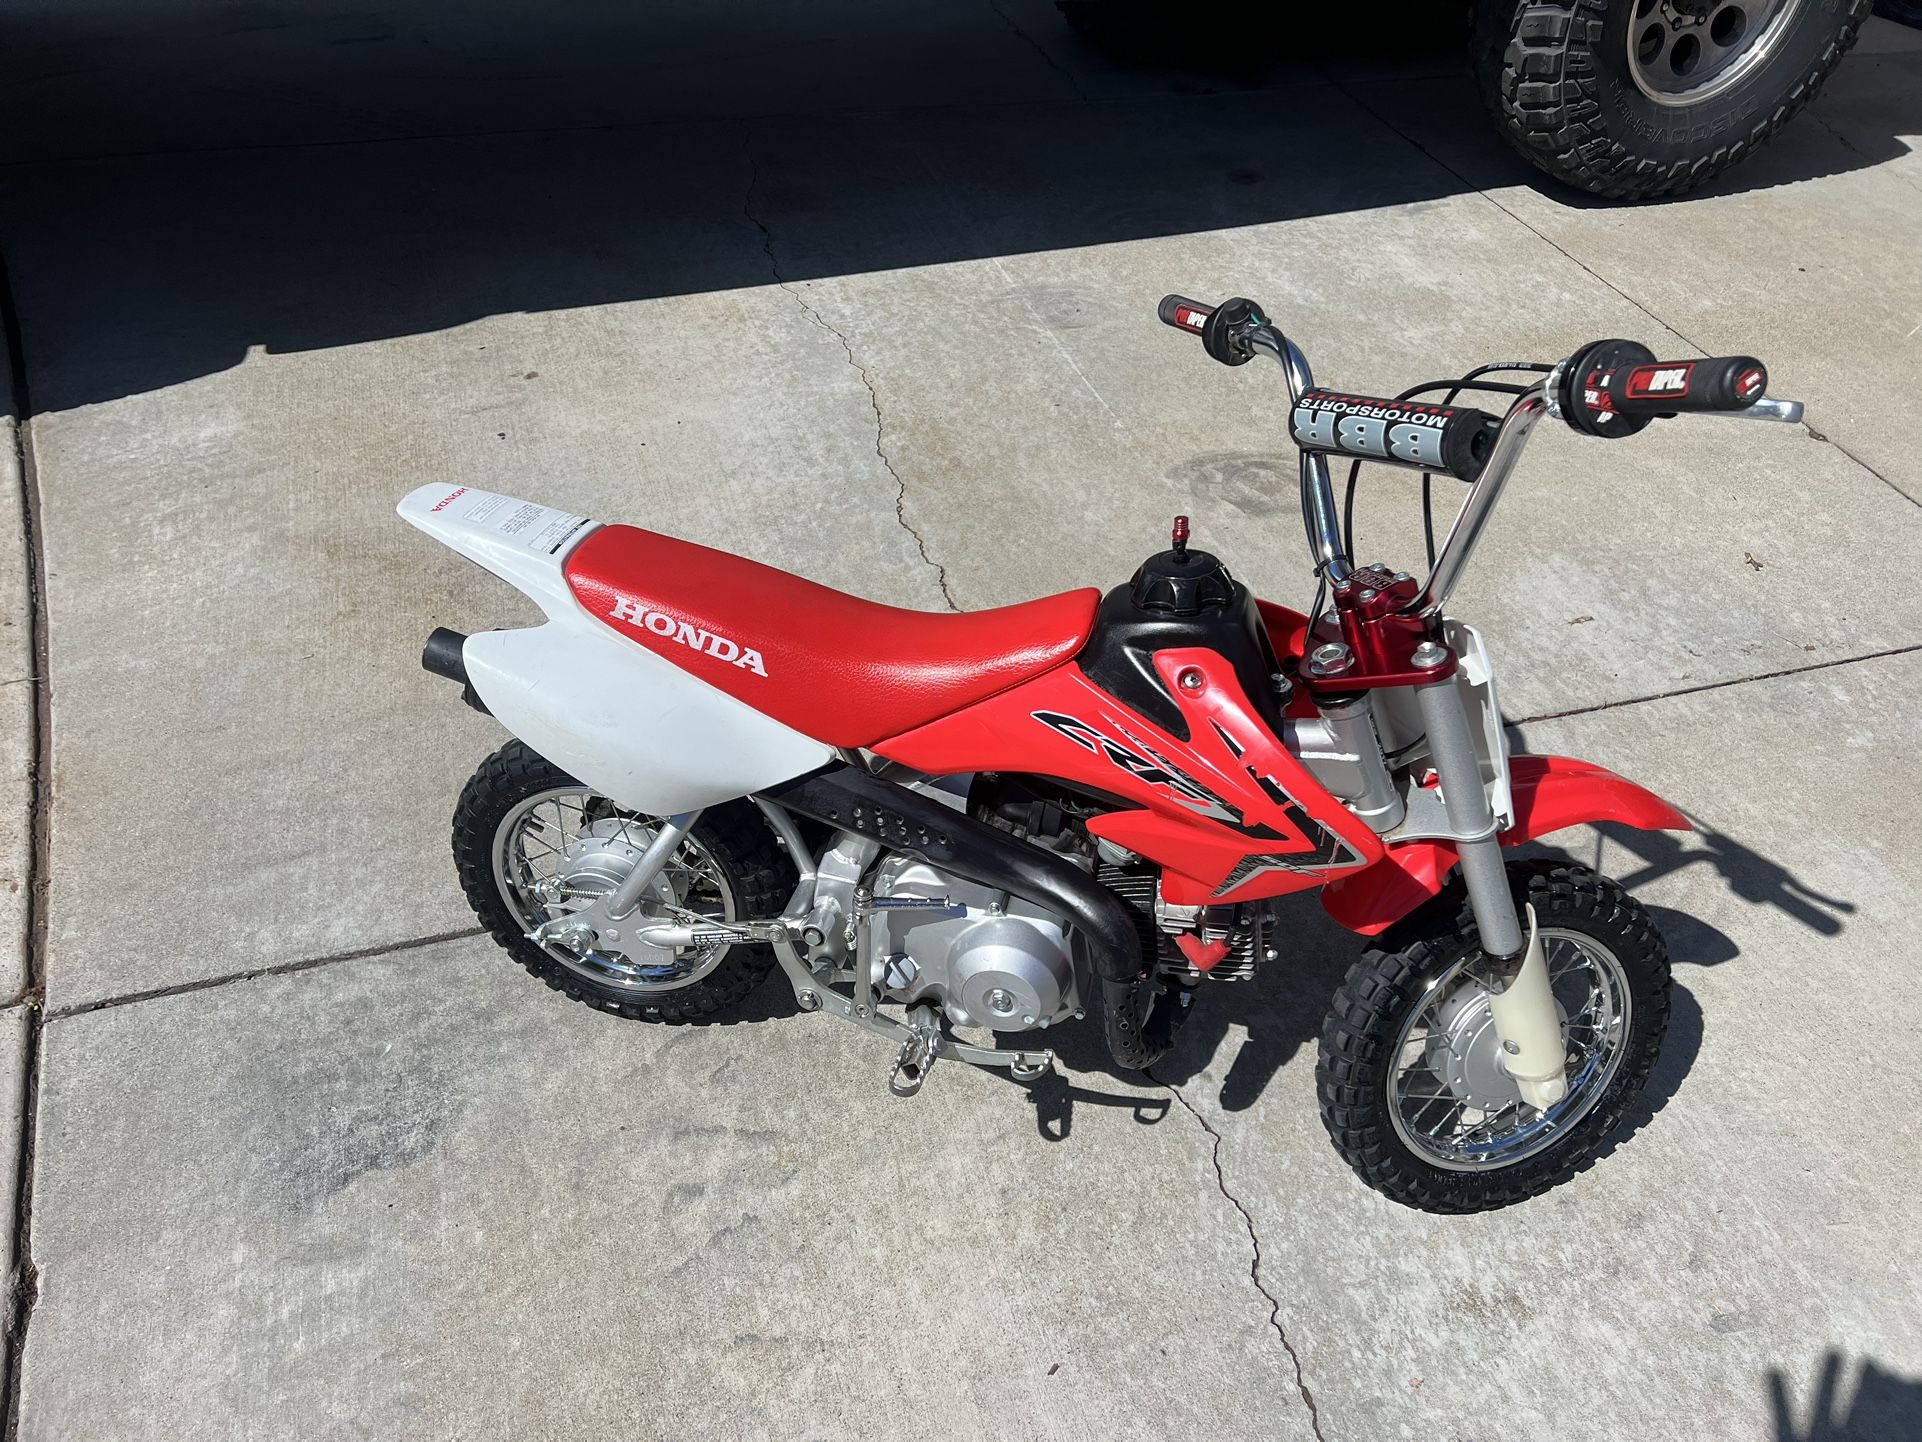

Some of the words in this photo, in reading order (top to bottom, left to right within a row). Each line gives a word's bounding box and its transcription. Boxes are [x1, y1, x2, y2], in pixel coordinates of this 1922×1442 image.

[1300, 398, 1448, 428] MOTORSPORTS
[1294, 408, 1447, 467] BBR
[432, 487, 470, 512] HONDA
[609, 596, 769, 678] HONDA
